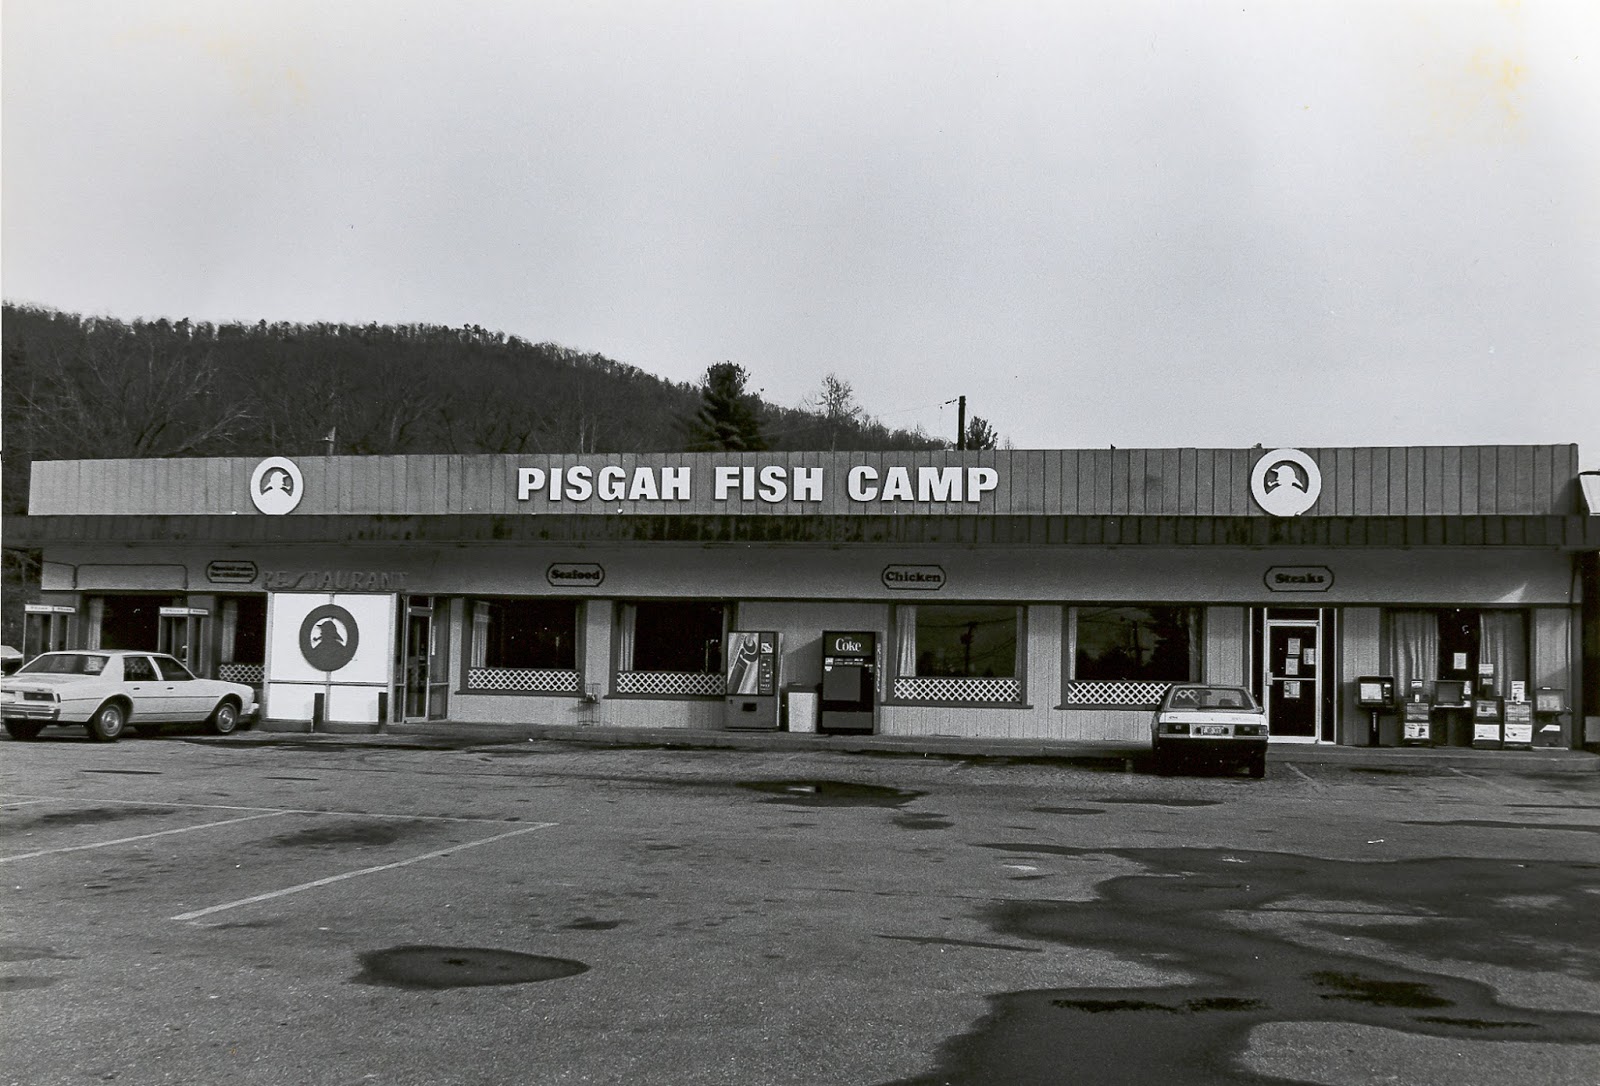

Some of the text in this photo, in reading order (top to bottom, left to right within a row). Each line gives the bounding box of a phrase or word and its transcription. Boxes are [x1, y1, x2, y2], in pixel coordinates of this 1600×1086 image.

[517, 465, 999, 504] PISGAH FISH CAMP
[551, 569, 600, 580] Seafood
[885, 571, 941, 582] Chicken
[1275, 573, 1324, 584] Steaks
[835, 638, 862, 653] Coke
